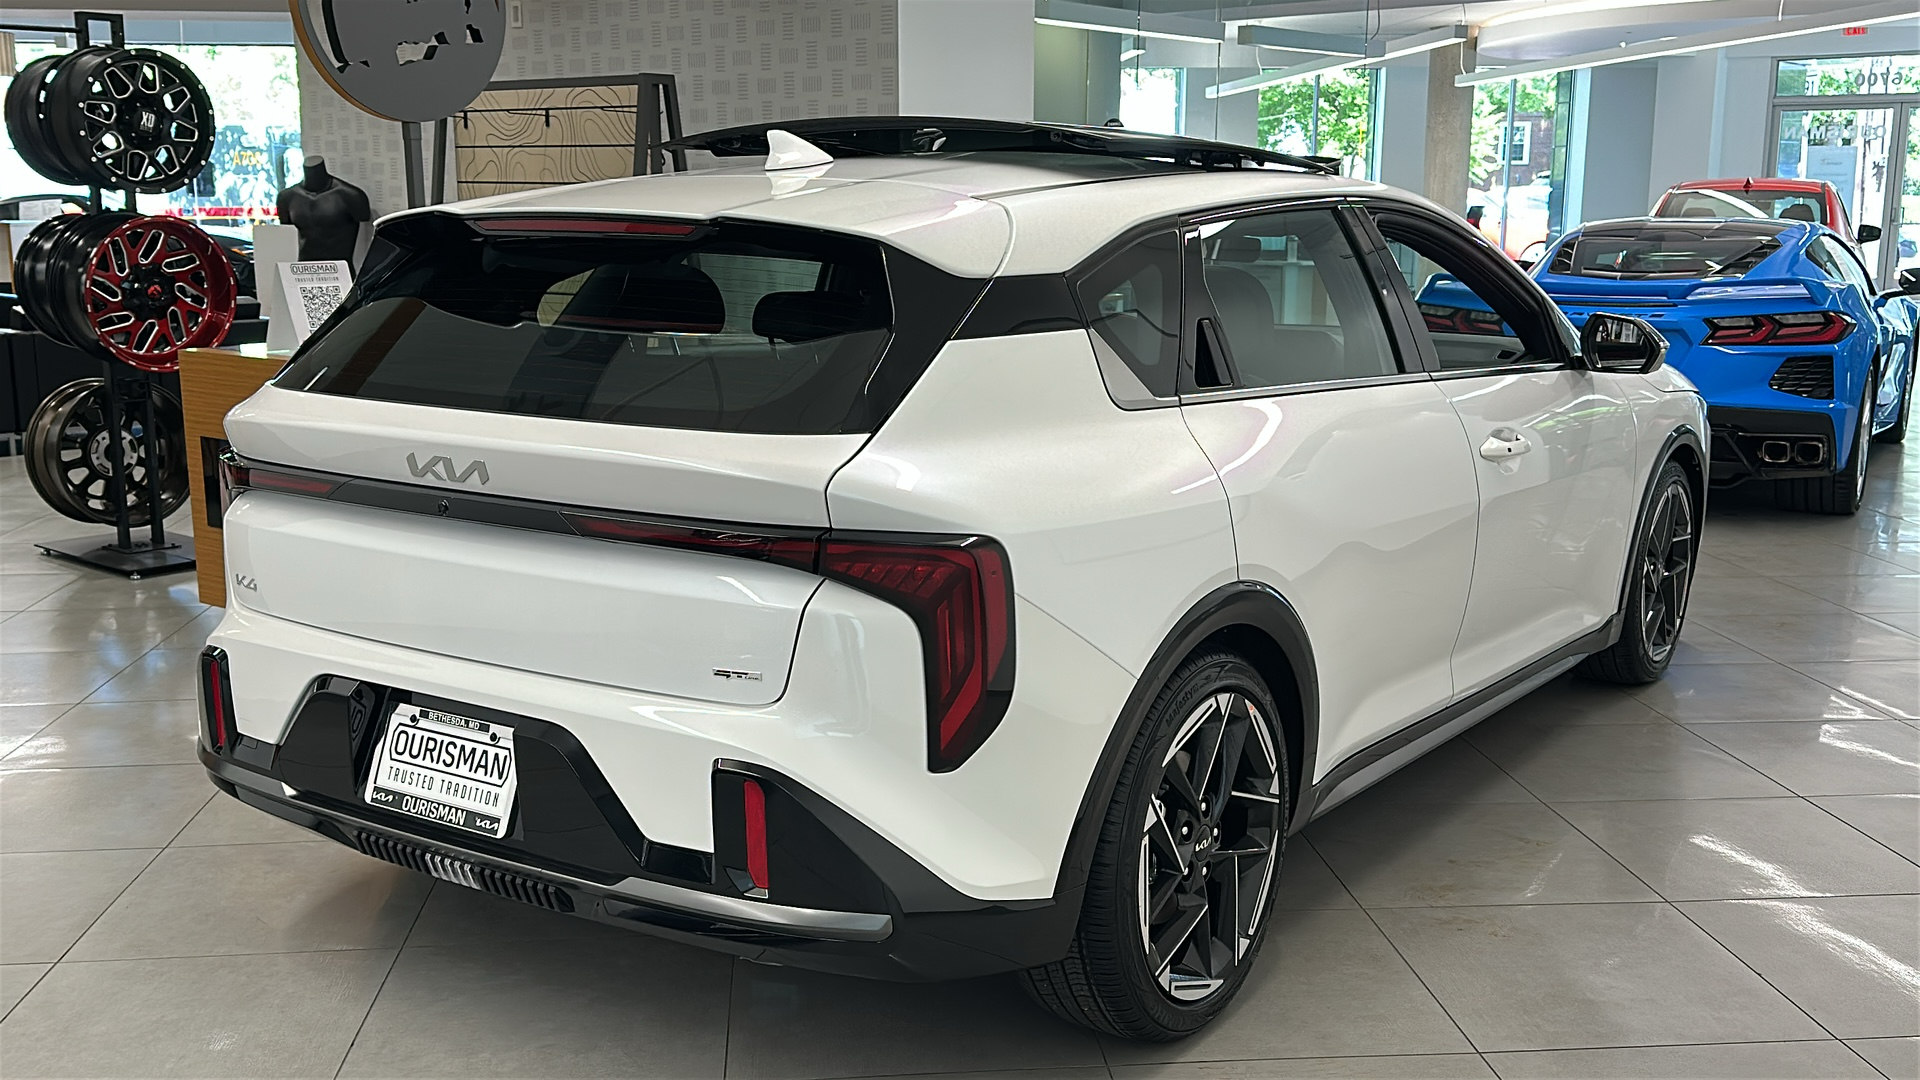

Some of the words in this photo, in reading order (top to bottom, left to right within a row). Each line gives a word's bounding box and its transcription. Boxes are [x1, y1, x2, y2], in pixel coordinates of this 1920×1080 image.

[140, 111, 155, 128] XD
[292, 264, 336, 274] OURISMAN
[405, 451, 490, 486] KIA
[235, 573, 258, 593] K4
[468, 719, 480, 731] MD
[394, 729, 508, 781] OURISMAN
[387, 765, 435, 791] TRUSTED
[439, 778, 500, 808] TRADITION
[372, 790, 394, 803] KIA
[401, 795, 467, 826] OURISMAN
[475, 817, 499, 831] KIA
[1195, 836, 1212, 852] KIA
